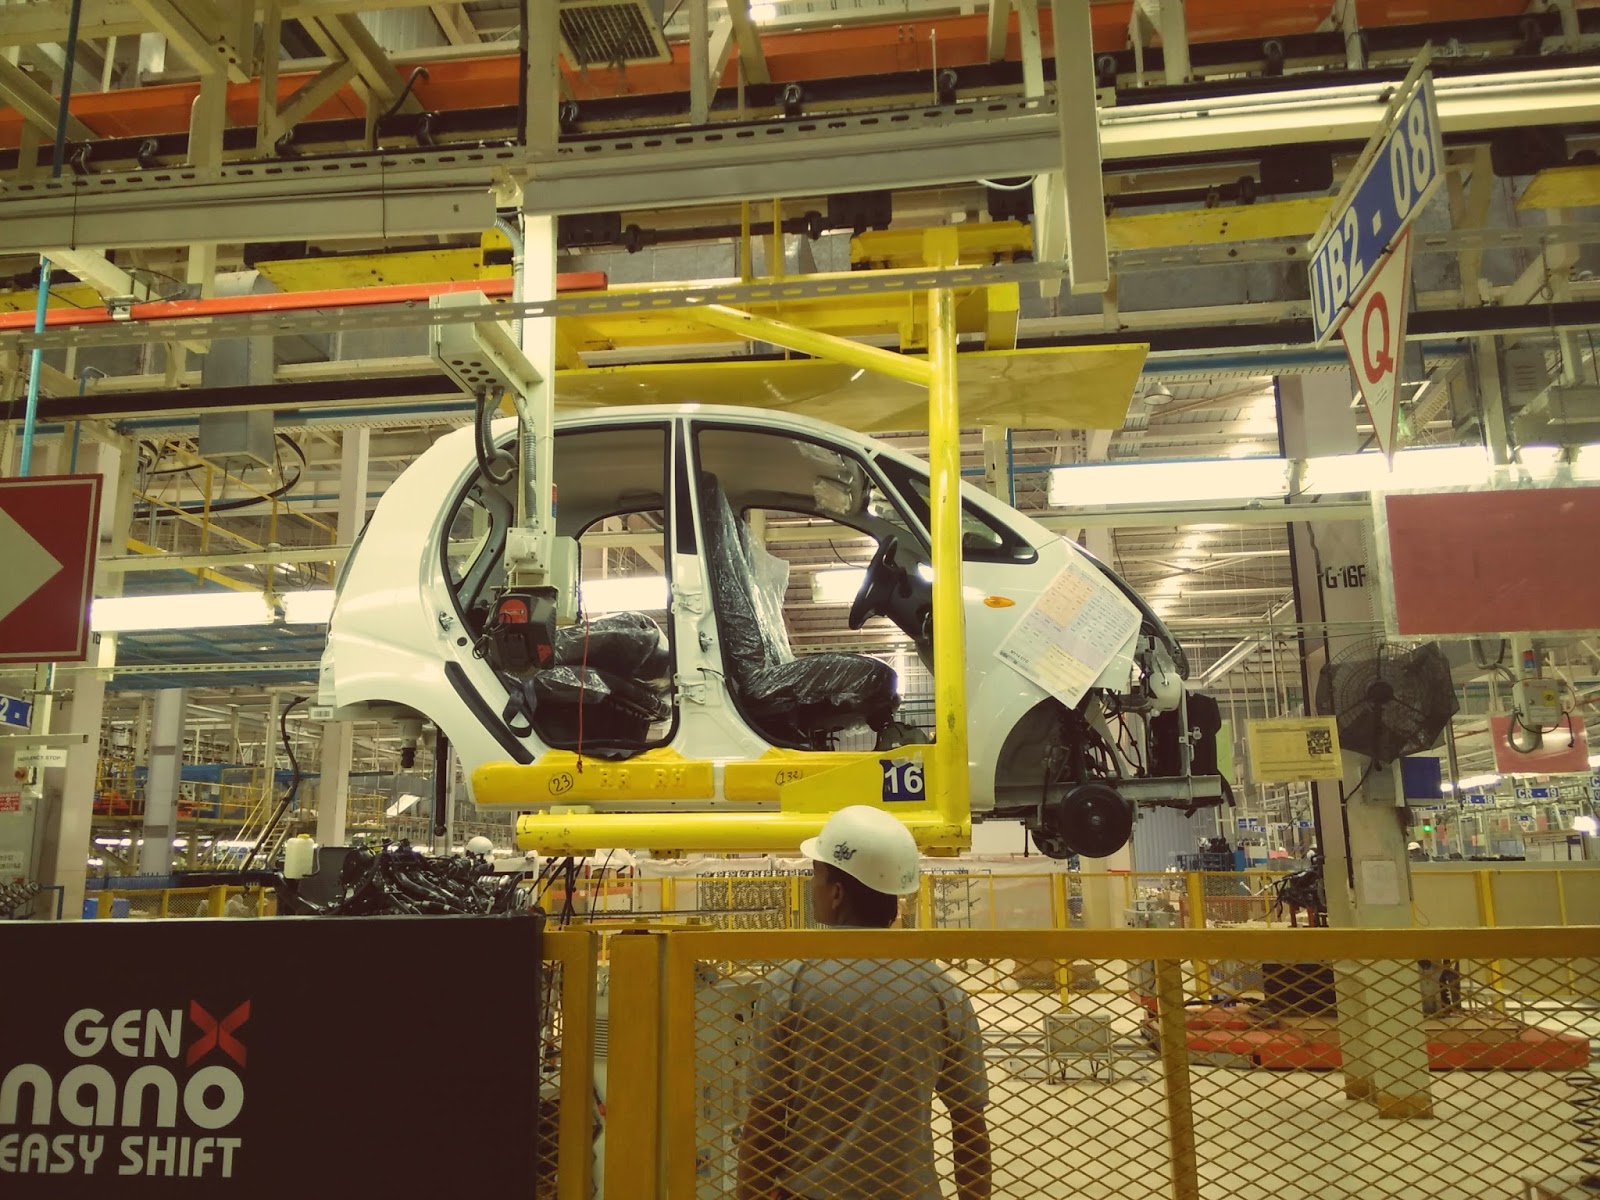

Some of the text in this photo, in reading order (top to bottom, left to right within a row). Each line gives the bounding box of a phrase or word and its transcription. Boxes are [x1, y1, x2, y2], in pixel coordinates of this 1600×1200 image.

[1315, 207, 1364, 332] UB2
[1390, 98, 1431, 219] 08
[1362, 291, 1393, 384] Q
[552, 774, 571, 792] 23
[885, 766, 923, 794] 16
[1517, 788, 1533, 798] CR
[1545, 788, 1558, 798] 19
[1483, 795, 1493, 804] 18
[0, 1063, 244, 1129] nano
[0, 1133, 241, 1178] EASY SHIFT
